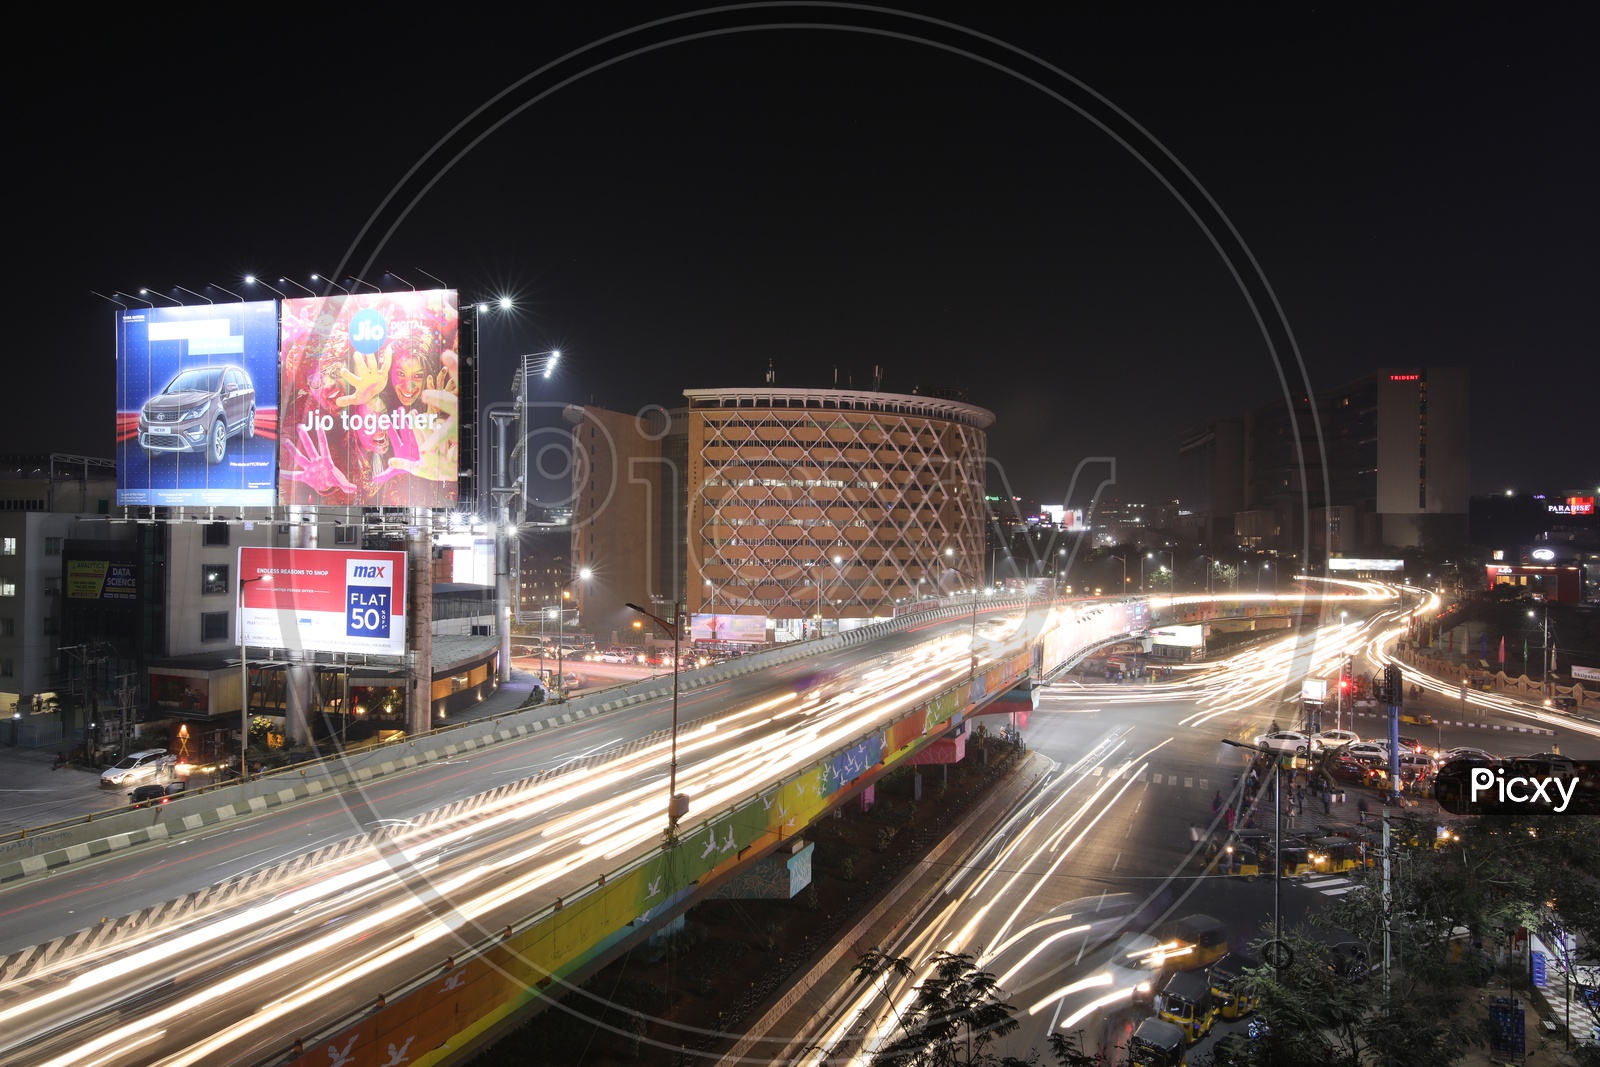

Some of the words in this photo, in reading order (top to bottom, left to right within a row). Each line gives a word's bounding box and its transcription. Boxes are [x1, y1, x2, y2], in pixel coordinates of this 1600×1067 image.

[352, 319, 384, 341] Jio
[390, 320, 424, 330] DIGITAL
[302, 410, 334, 432] Jio
[340, 408, 442, 434] together.
[112, 568, 131, 576] DATA
[353, 565, 385, 580] max
[107, 578, 136, 586] SCIENCE
[351, 593, 386, 606] FLAT
[351, 608, 380, 630] 50
